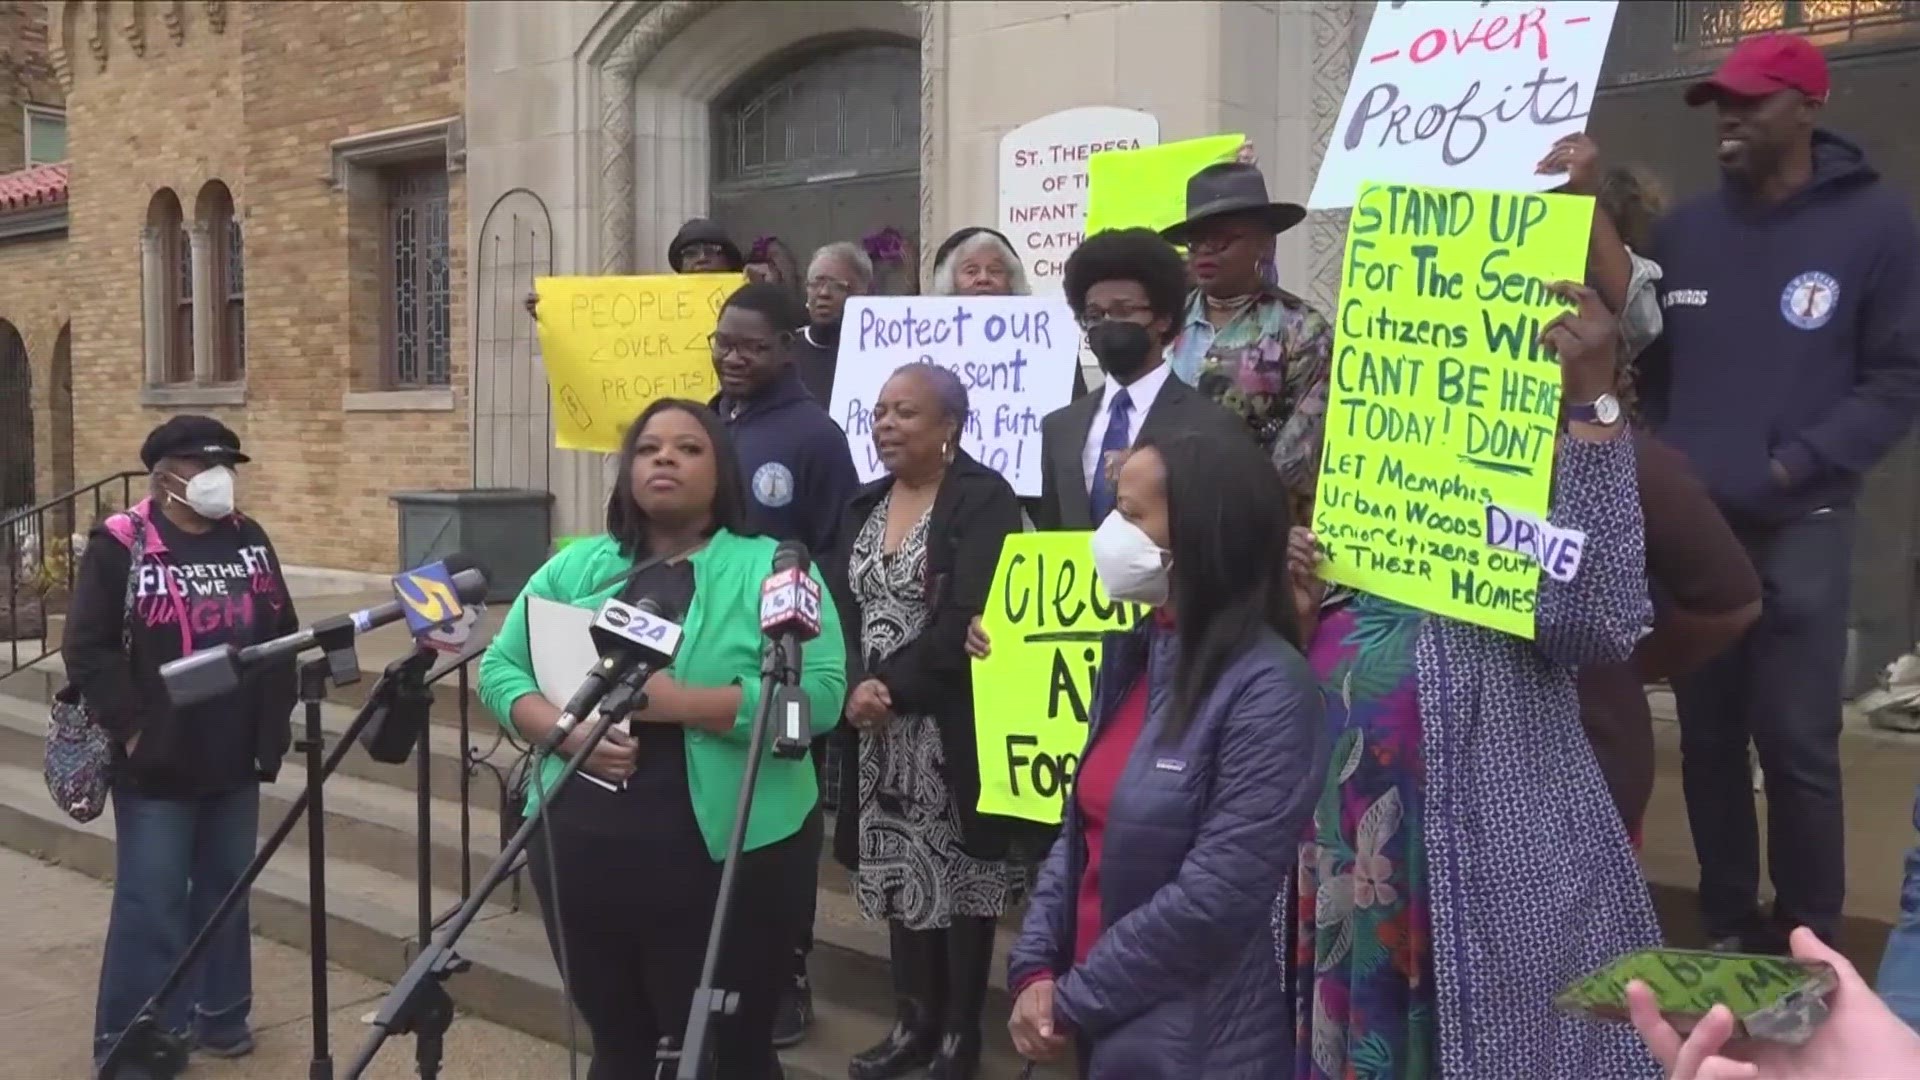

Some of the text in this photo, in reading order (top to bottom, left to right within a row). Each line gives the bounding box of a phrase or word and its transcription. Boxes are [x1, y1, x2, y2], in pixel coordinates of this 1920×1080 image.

[1042, 175, 1068, 192] OF
[1009, 203, 1078, 224] INFANT
[1353, 186, 1548, 247] STAND UP
[571, 291, 696, 329] PEOPLE
[1343, 299, 1468, 348] Citizens
[1337, 345, 1561, 420] CAN'T BE HERE
[1323, 441, 1493, 504] LET Memphis
[1323, 483, 1396, 521] Urban
[1486, 505, 1579, 576] DRIVE
[192, 580, 228, 596] WE
[1451, 569, 1536, 614] HOMES
[628, 616, 667, 642] 24
